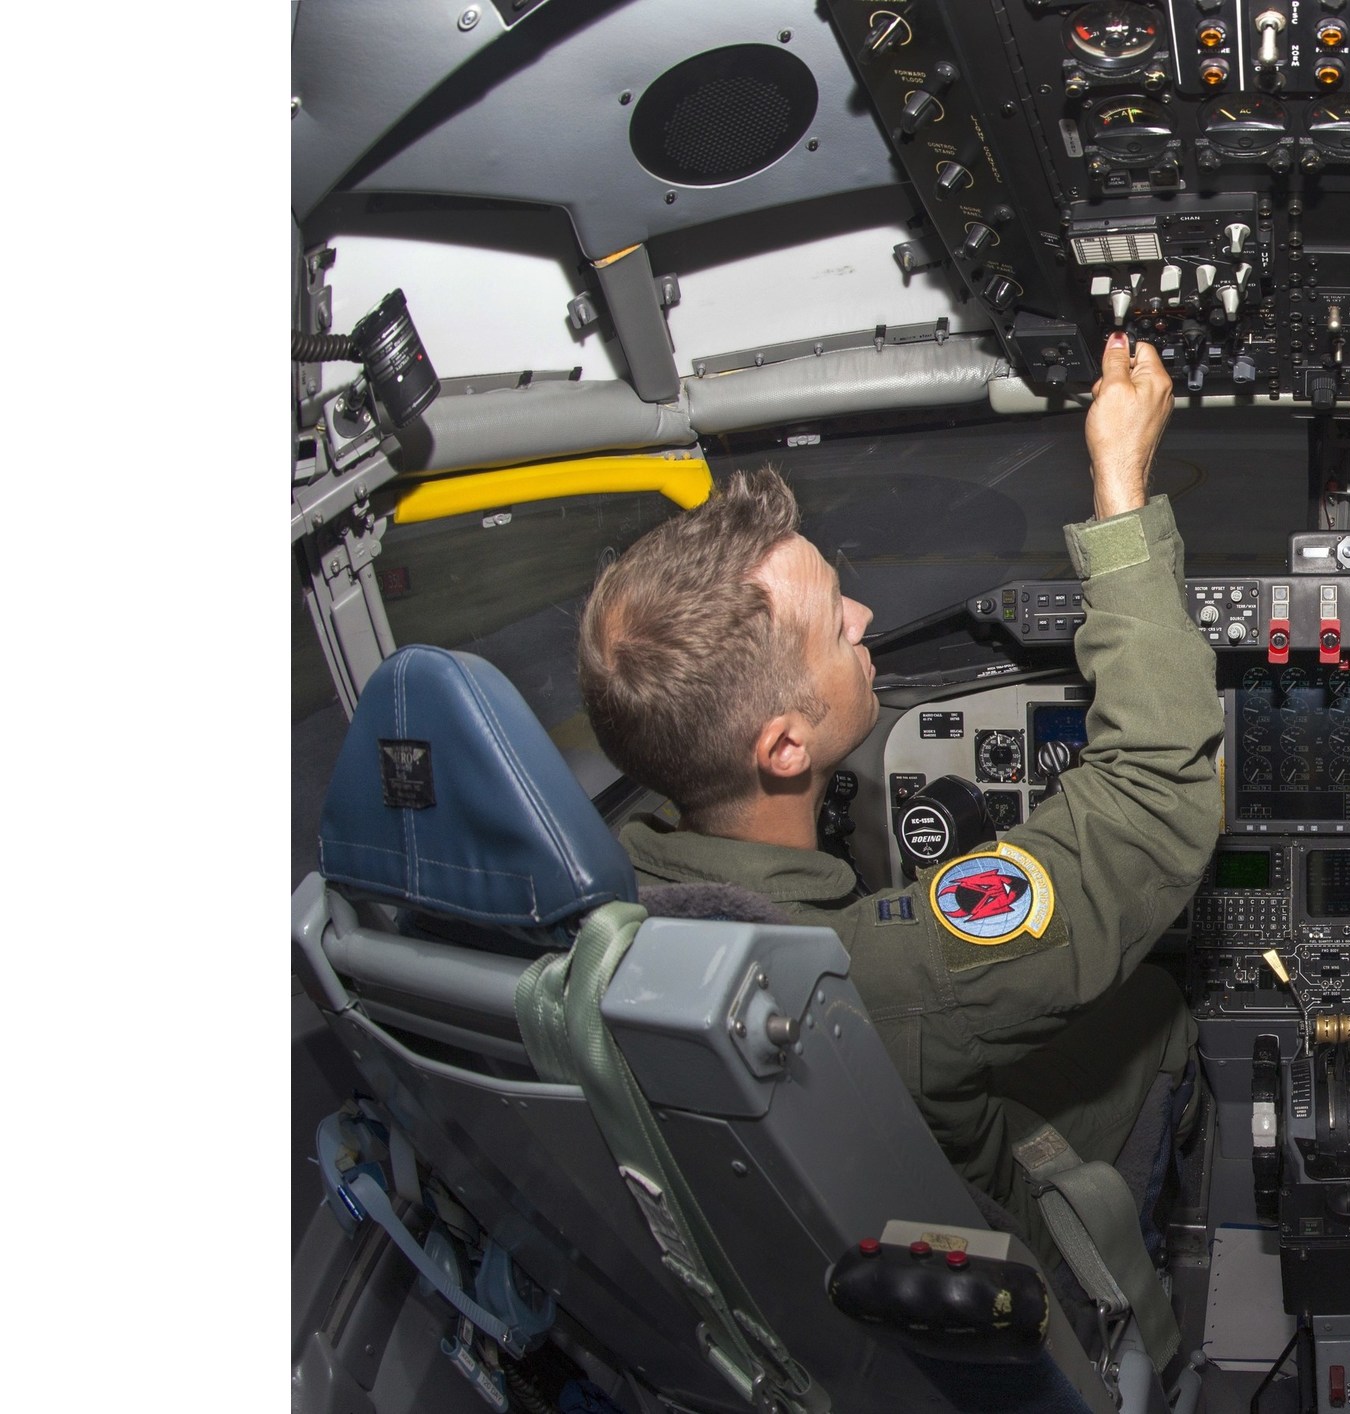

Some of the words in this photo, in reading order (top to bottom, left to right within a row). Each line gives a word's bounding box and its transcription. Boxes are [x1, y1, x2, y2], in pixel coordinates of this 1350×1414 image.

[1291, 1, 1300, 24] DISC
[1291, 45, 1300, 67] NORM
[894, 69, 926, 78] FORWARD
[901, 76, 923, 84] FLOOD
[927, 141, 957, 150] CONTROL
[934, 148, 956, 156] STAND
[911, 817, 935, 825] KC-135R
[911, 835, 942, 844] BOEING
